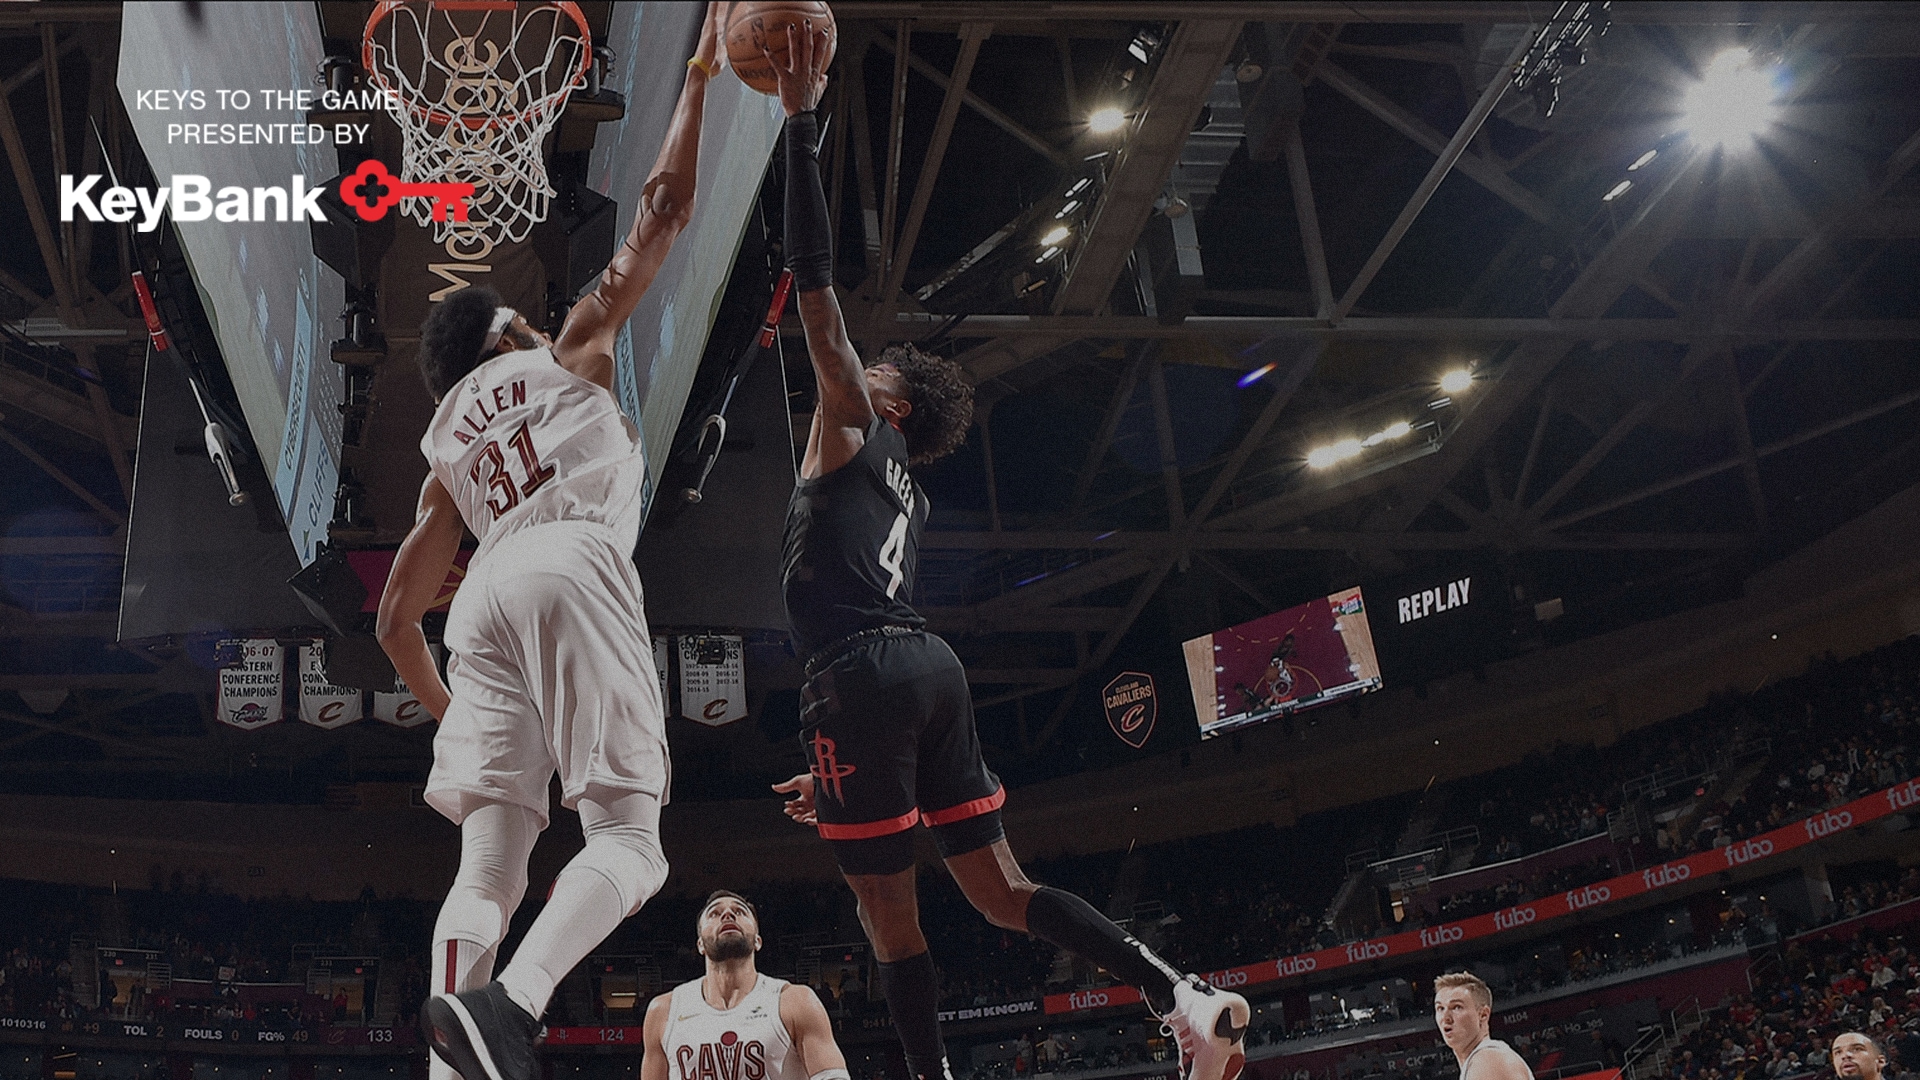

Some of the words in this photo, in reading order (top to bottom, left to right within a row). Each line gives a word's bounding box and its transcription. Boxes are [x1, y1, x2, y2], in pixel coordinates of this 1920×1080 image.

[453, 380, 526, 445] ALLEN
[470, 420, 556, 521] 31
[308, 440, 329, 527] CLIFFS
[878, 511, 910, 600] 4
[1397, 576, 1471, 625] REPLAY
[222, 673, 280, 684] CONFERENCE
[224, 686, 277, 697] CHAMPIONS
[304, 686, 357, 696] CHAMPIONS
[1106, 685, 1152, 709] CAVALIERS
[1886, 781, 1920, 810] fub
[1804, 811, 1853, 840] fubo
[1725, 839, 1774, 866] fubo
[1643, 863, 1691, 889] fubo
[1566, 884, 1611, 911] fubo
[1494, 906, 1536, 930] fubo
[1419, 924, 1463, 948] fubo
[1346, 940, 1388, 962] fubo
[1276, 956, 1317, 977] fubo
[1207, 970, 1248, 988] fubo
[938, 1011, 956, 1021] ET
[958, 1008, 982, 1019] EM
[983, 1001, 1037, 1017] KNOW.
[1069, 991, 1109, 1009] fubo
[1, 1018, 46, 1029] 1010316
[124, 1025, 147, 1036] TOL
[156, 1026, 165, 1037] 2
[184, 1029, 223, 1040] FOULS
[231, 1030, 239, 1041] 0
[257, 1031, 285, 1041] FG%
[292, 1030, 308, 1042] 49
[366, 1029, 393, 1043] 133
[599, 1029, 624, 1041] 124
[676, 1040, 765, 1080] CAVS
